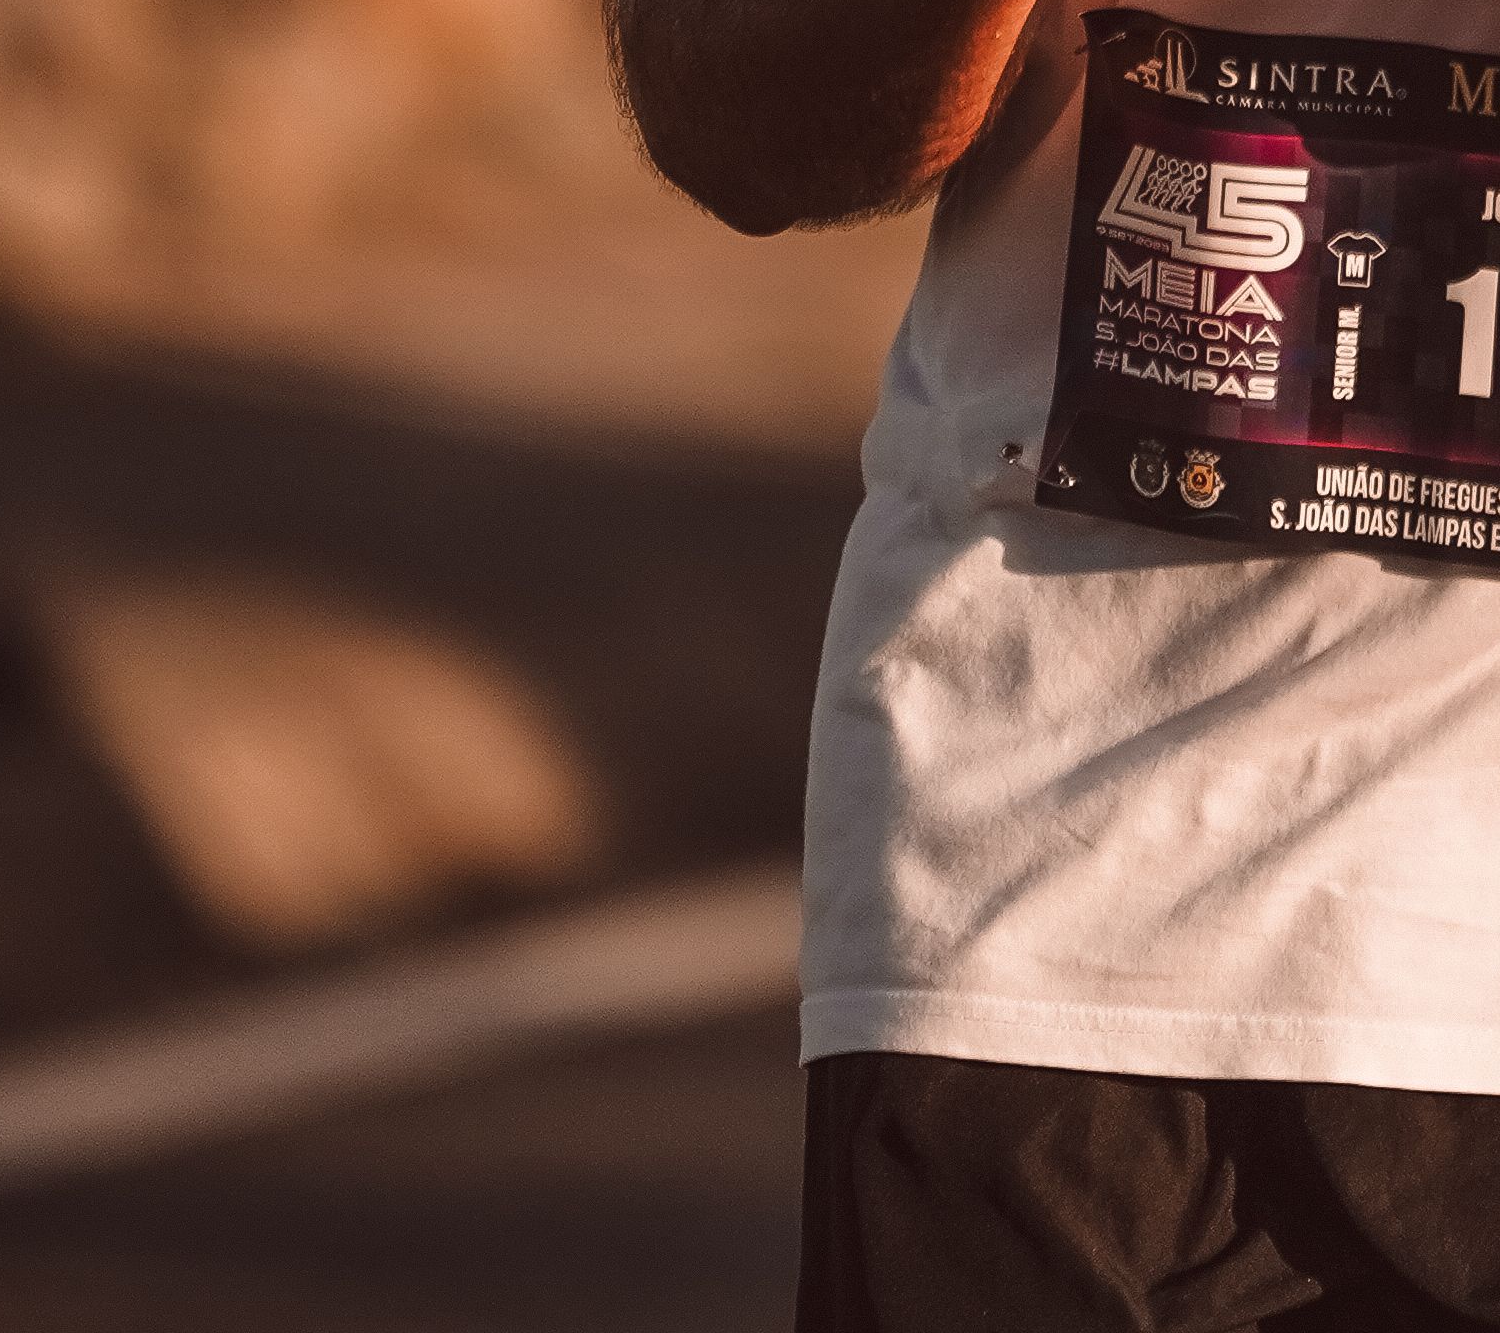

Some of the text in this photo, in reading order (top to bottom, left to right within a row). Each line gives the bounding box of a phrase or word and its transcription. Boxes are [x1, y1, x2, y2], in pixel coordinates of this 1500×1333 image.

[1298, 99, 1394, 117] MUNICIPAL
[1097, 144, 1311, 273] 45
[1103, 245, 1284, 322] MEIA
[1345, 253, 1366, 278] M
[1095, 320, 1280, 372] S. JOÃO DAS
[1100, 293, 1281, 346] MARATONA
[1094, 348, 1279, 401] #LAMPAS
[1332, 330, 1359, 400] SENIOR
[1316, 462, 1383, 500] UNIÃO
[1388, 472, 1415, 504] DE
[1269, 498, 1291, 531] S.
[1296, 498, 1350, 533] JOÃO
[1355, 506, 1399, 537] DAS
[1403, 511, 1485, 551] LAMPAS
